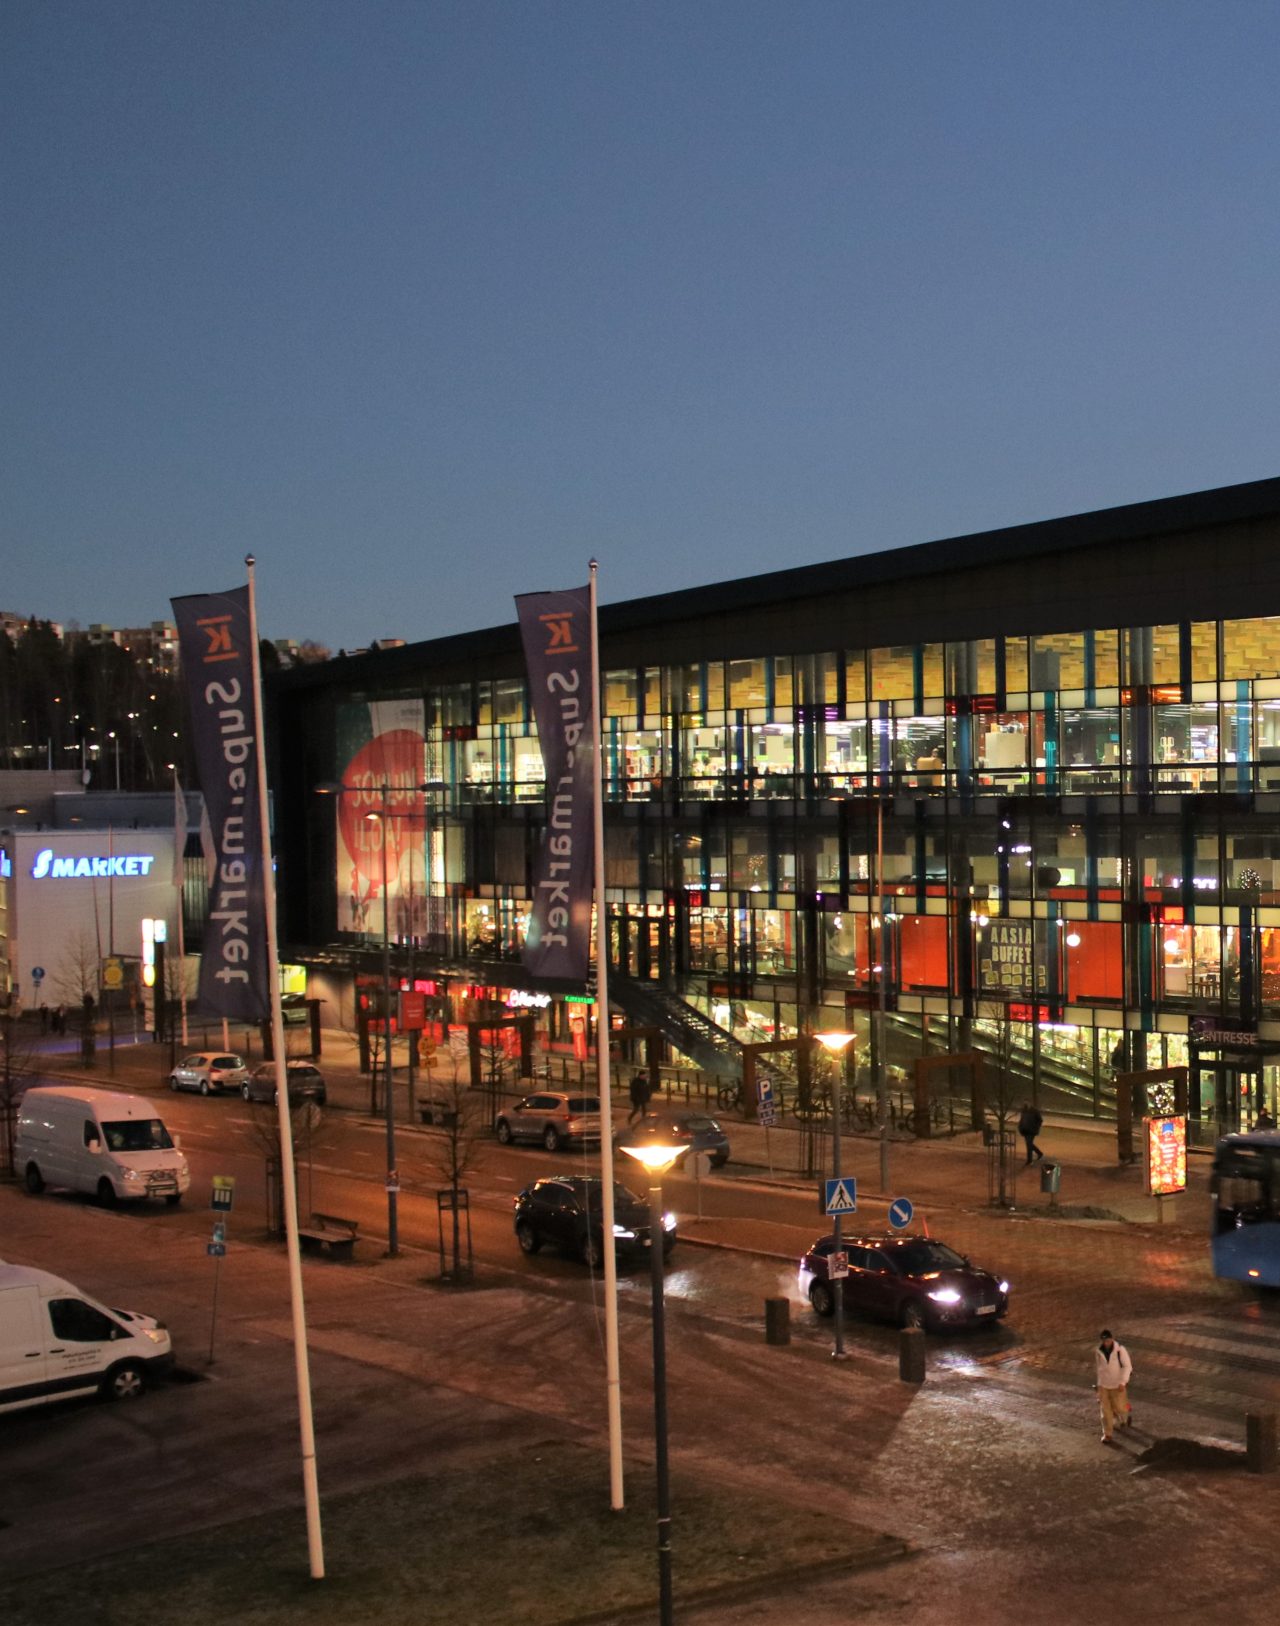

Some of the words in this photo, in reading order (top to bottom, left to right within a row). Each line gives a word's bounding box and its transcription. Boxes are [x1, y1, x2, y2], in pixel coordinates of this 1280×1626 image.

[990, 926, 1032, 944] AASIA
[991, 945, 1032, 963] BUFFET
[1203, 1031, 1258, 1045] ENTRESSE
